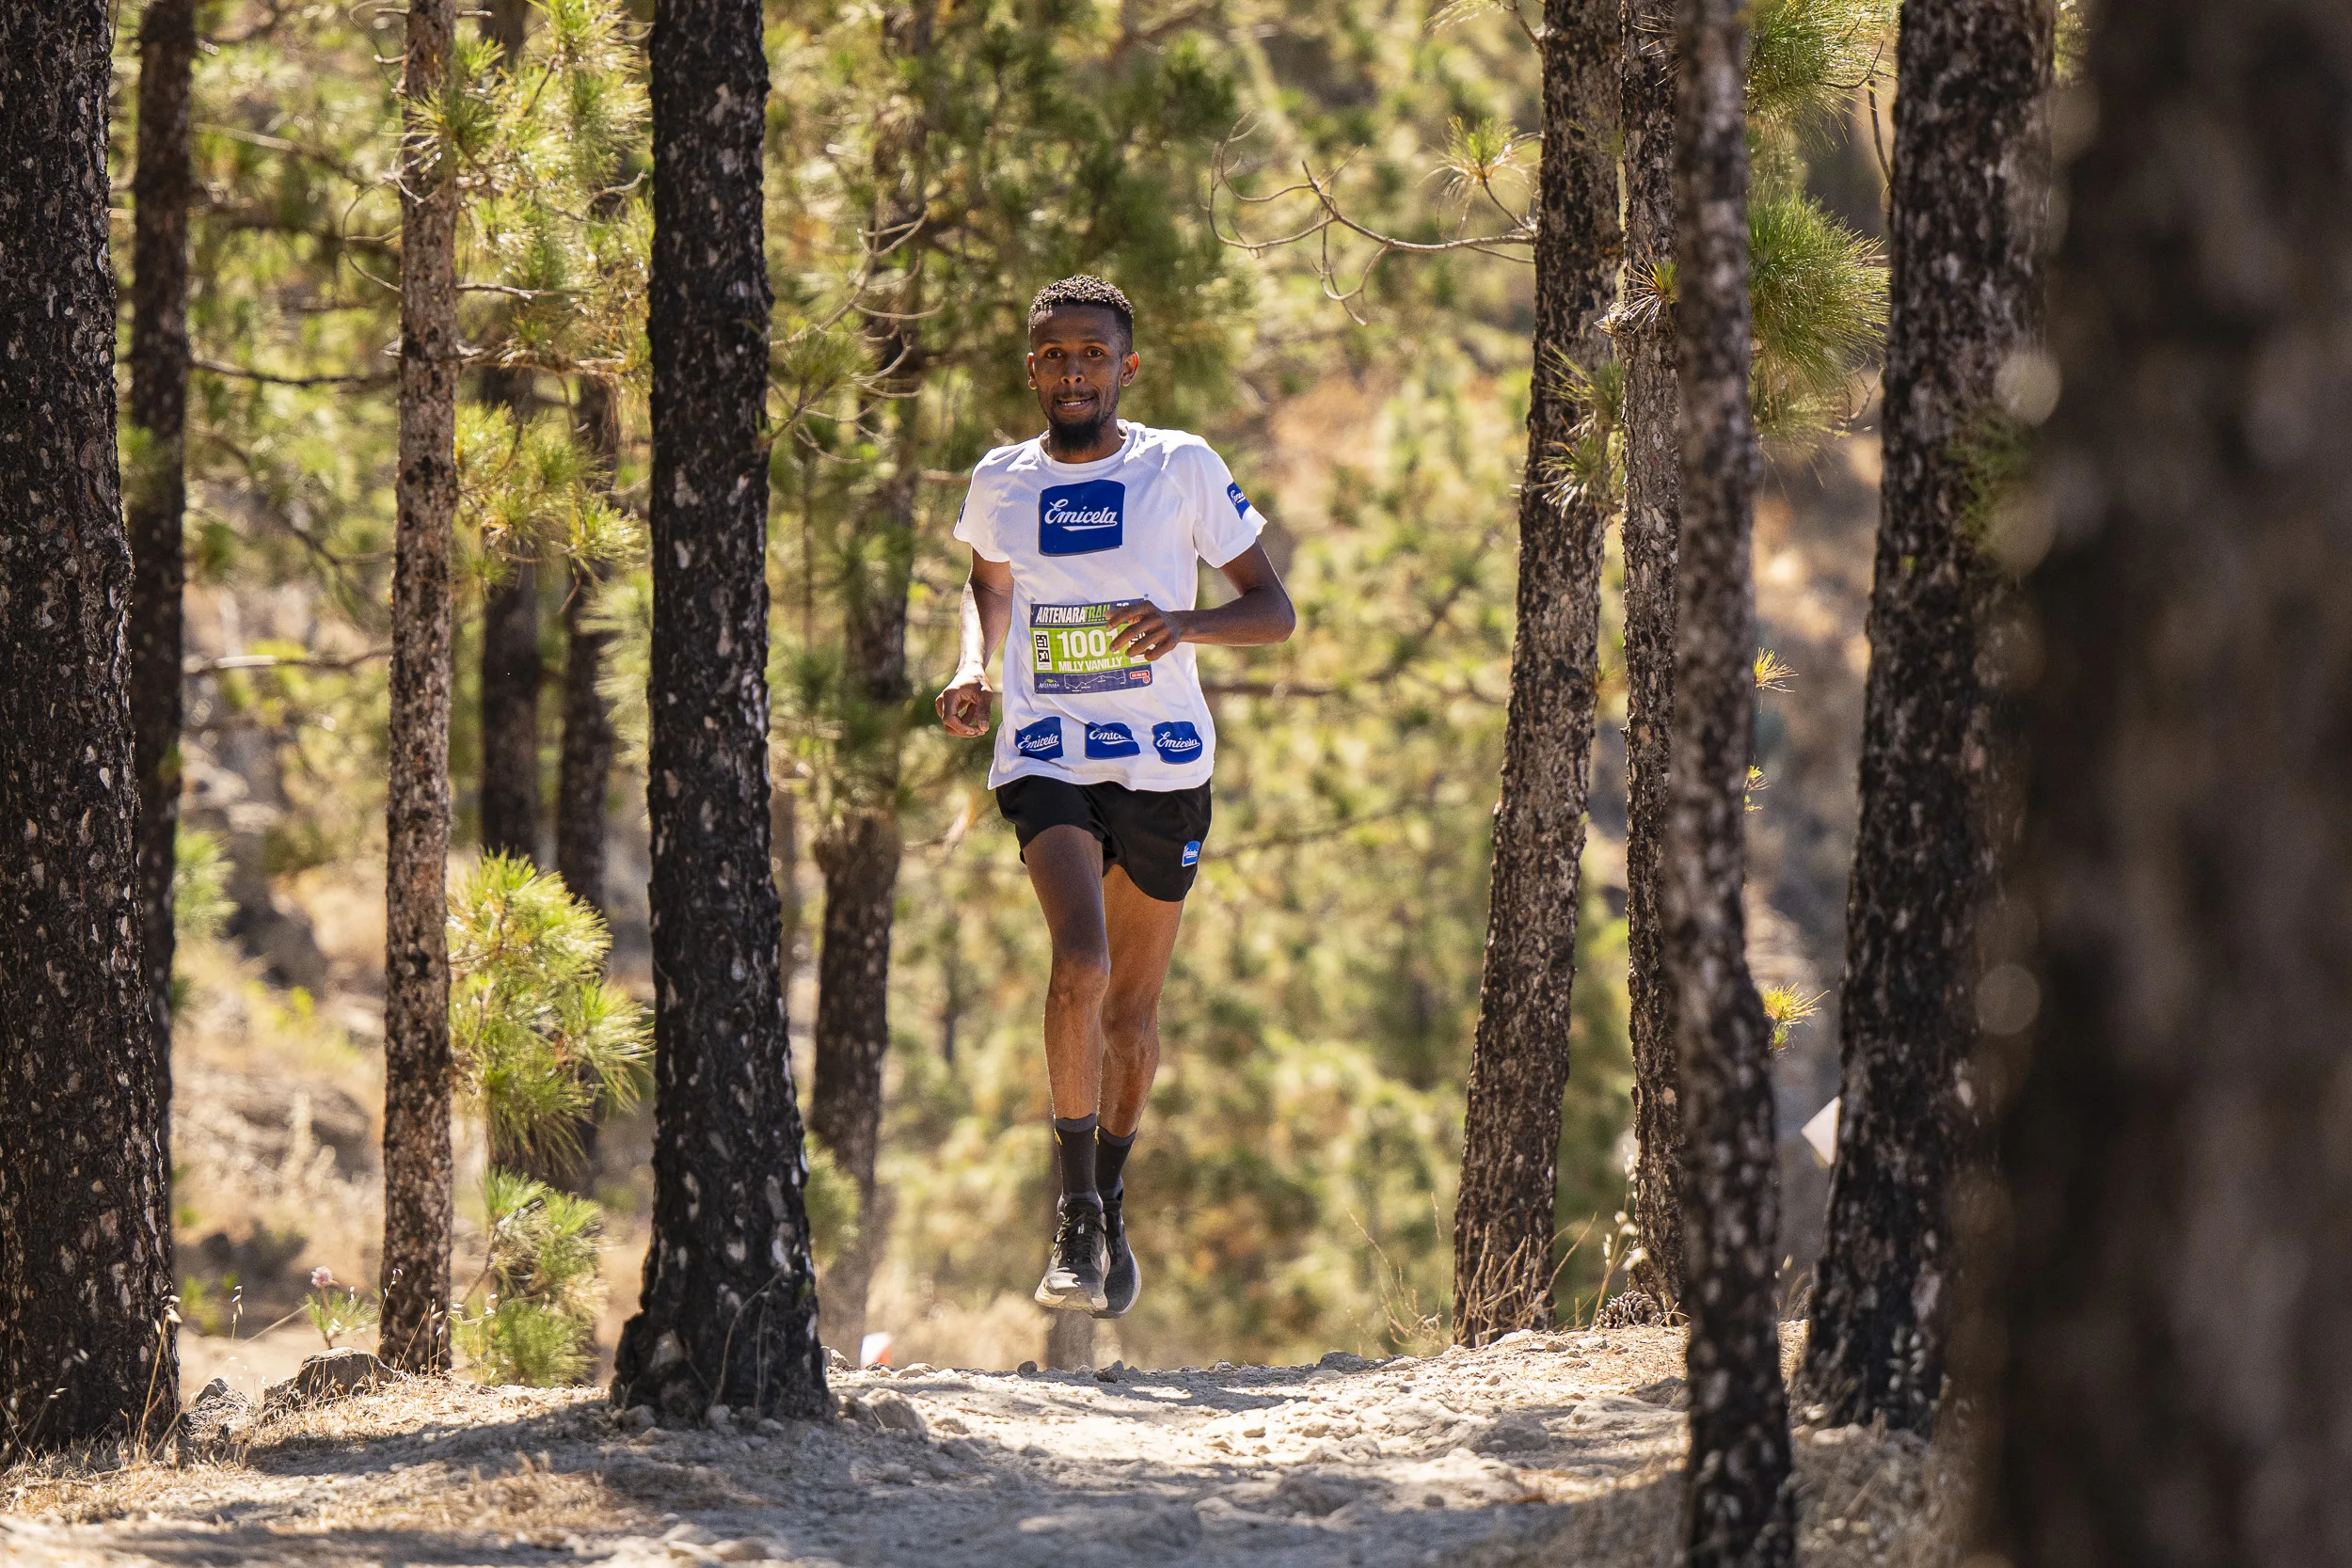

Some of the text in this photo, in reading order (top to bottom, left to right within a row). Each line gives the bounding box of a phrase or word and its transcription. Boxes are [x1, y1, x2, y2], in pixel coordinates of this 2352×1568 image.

[1044, 499, 1118, 531] Emicela
[1057, 660, 1083, 672] MILLY
[1085, 657, 1123, 671] VANILLY
[1017, 733, 1059, 752] Emicela
[1156, 731, 1200, 752] Emicela
